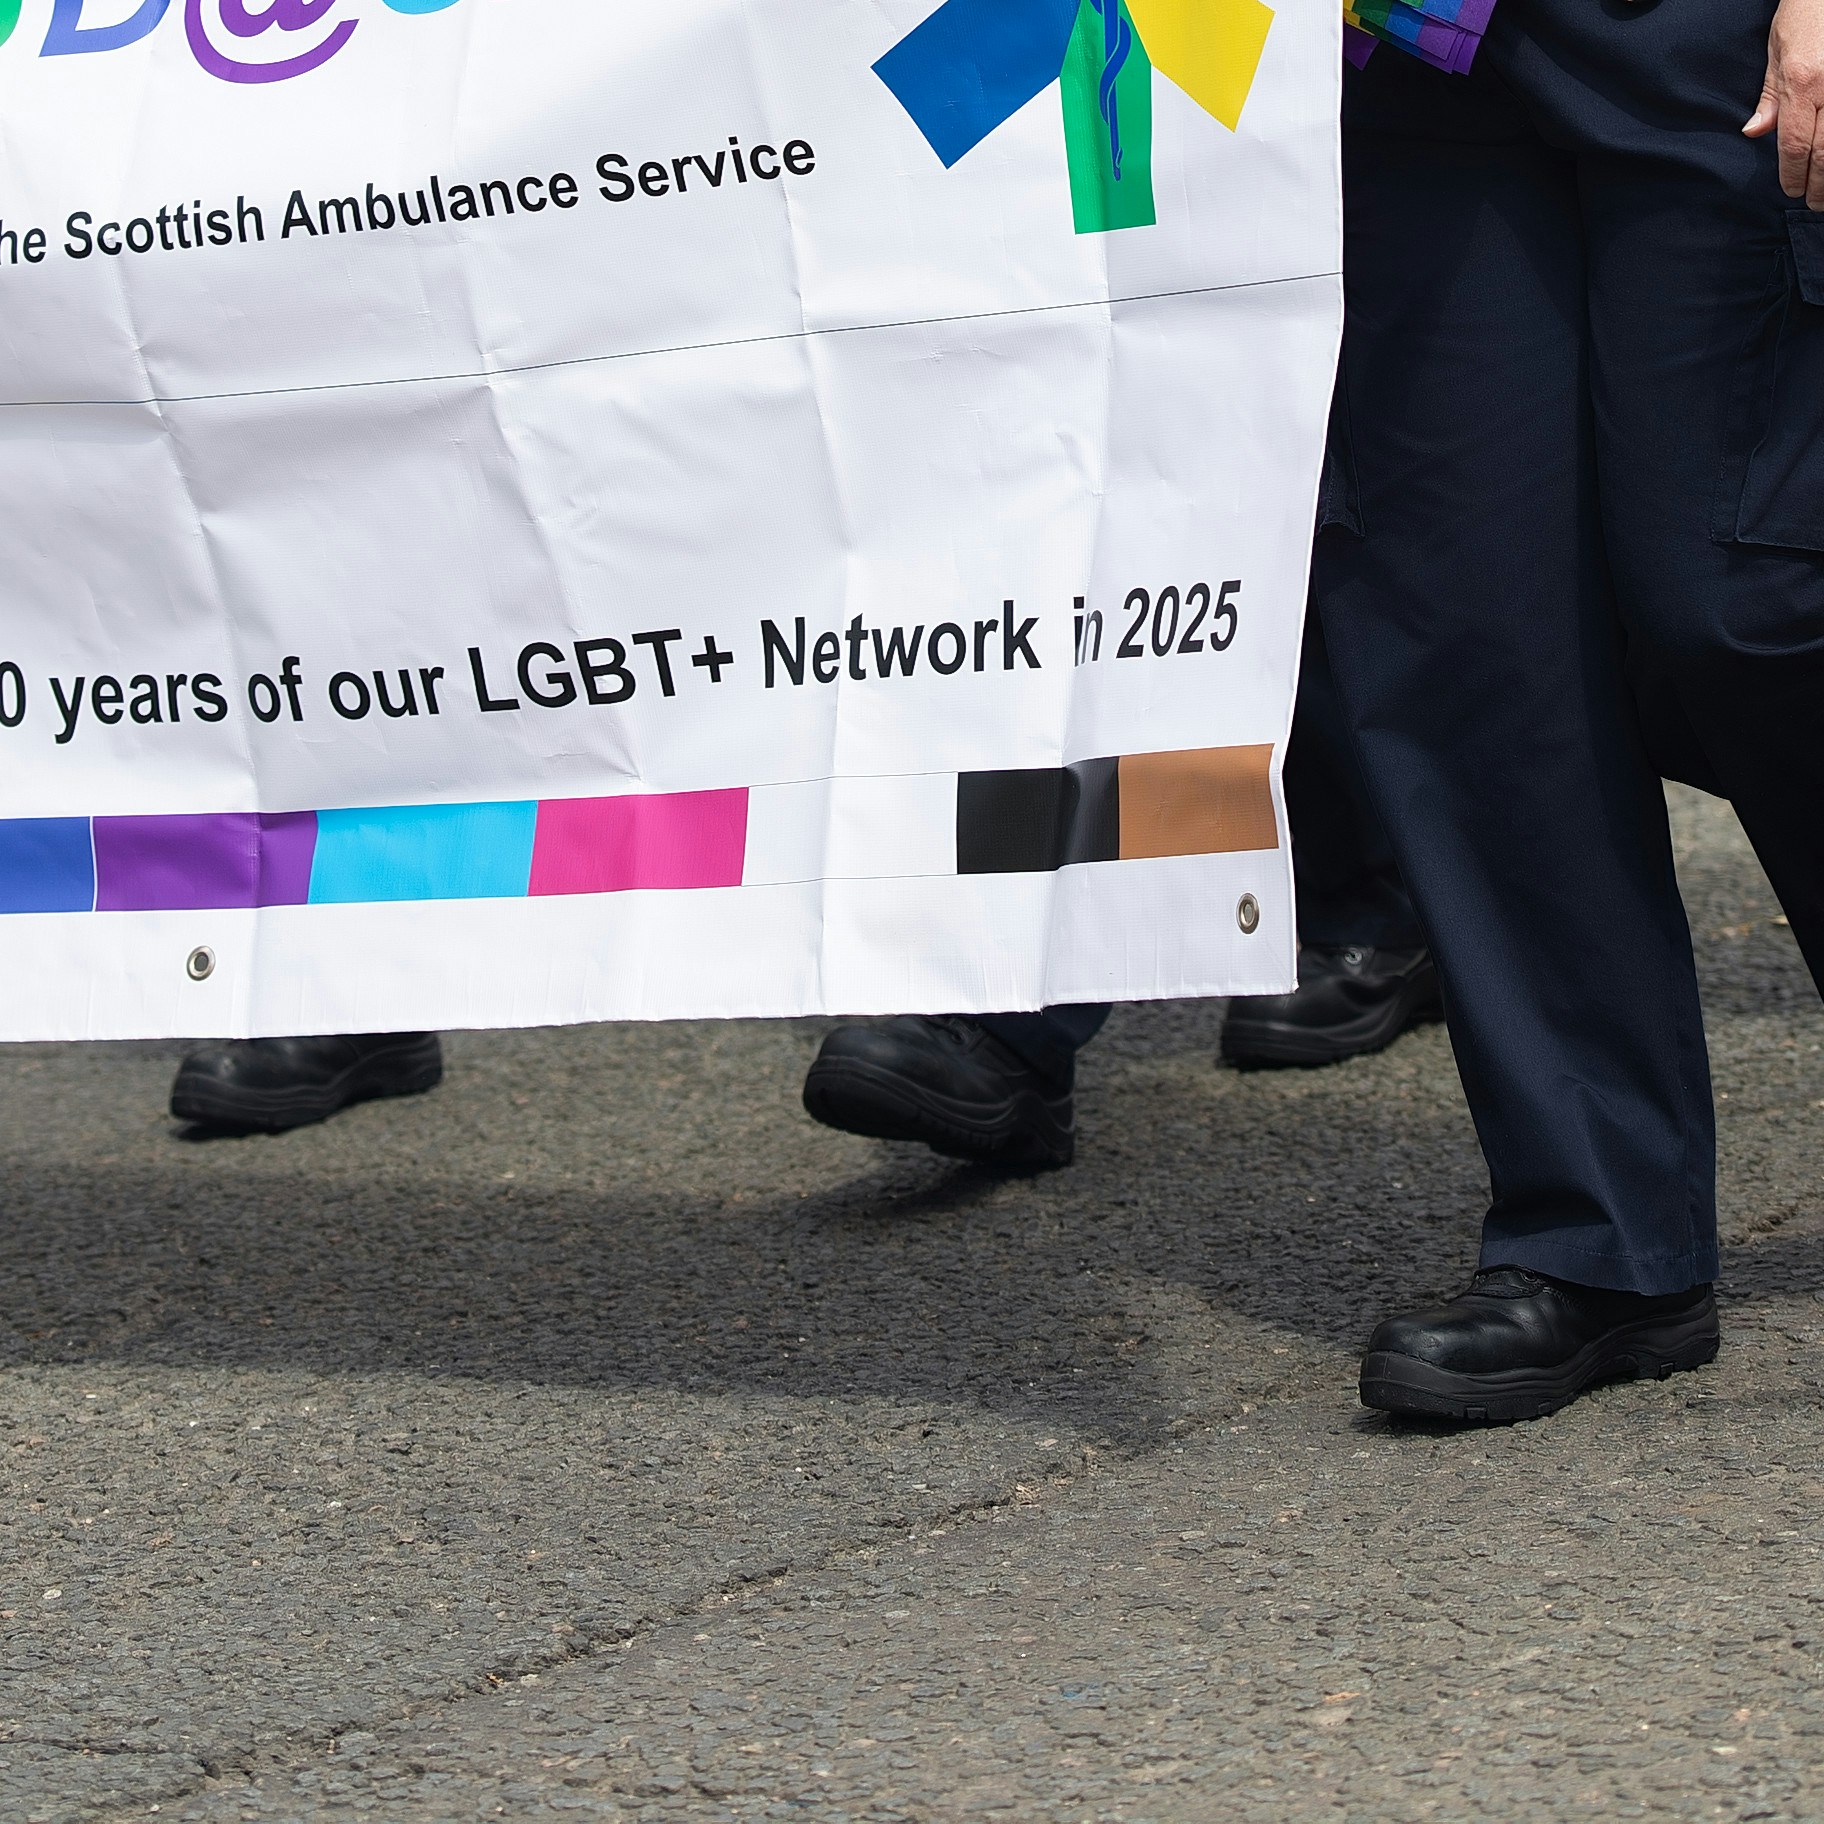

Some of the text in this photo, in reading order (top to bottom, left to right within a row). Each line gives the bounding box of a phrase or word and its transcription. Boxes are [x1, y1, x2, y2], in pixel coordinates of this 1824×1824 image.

[65, 196, 266, 260] Scottish
[282, 173, 580, 240] Ambulance
[596, 137, 817, 204] Service
[50, 666, 229, 746] years
[248, 656, 305, 724] of
[329, 667, 446, 722] our
[468, 629, 735, 714] LGBT+
[761, 600, 1043, 690] Network
[1073, 596, 1104, 668] in
[1117, 580, 1243, 660] 2025
